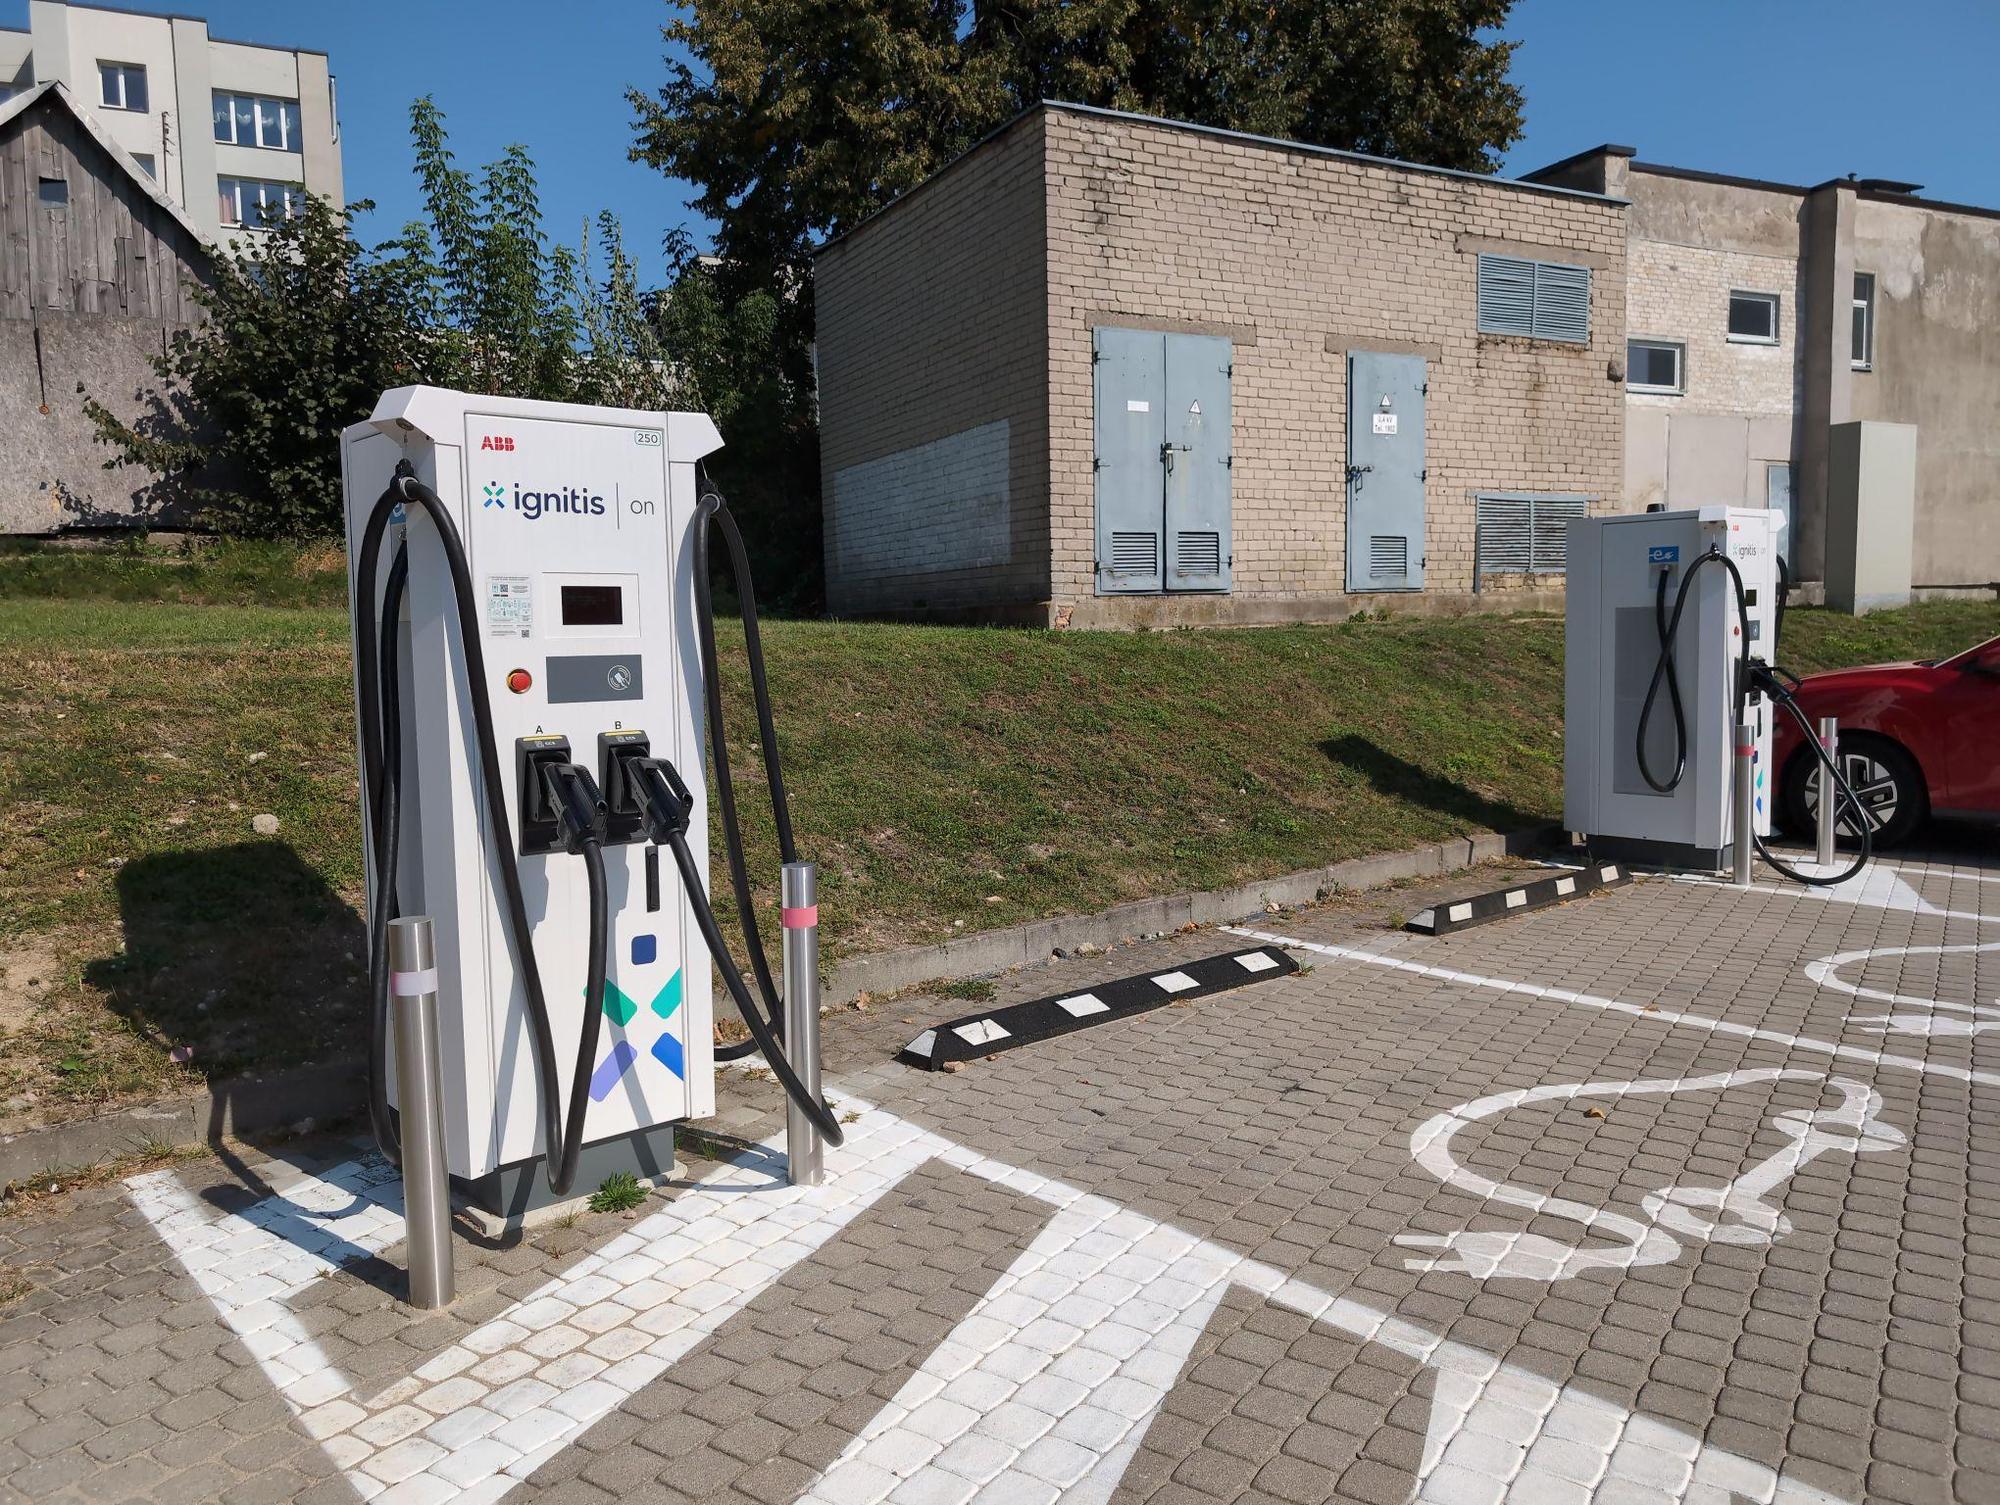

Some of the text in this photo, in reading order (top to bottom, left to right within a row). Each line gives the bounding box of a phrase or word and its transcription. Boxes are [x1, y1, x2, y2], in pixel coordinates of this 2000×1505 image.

[481, 435, 515, 451] ABB
[637, 433, 658, 443] 250
[514, 482, 654, 520] ignitis on
[1739, 543, 1757, 560] ignitis
[536, 726, 544, 734] A
[614, 721, 622, 730] B
